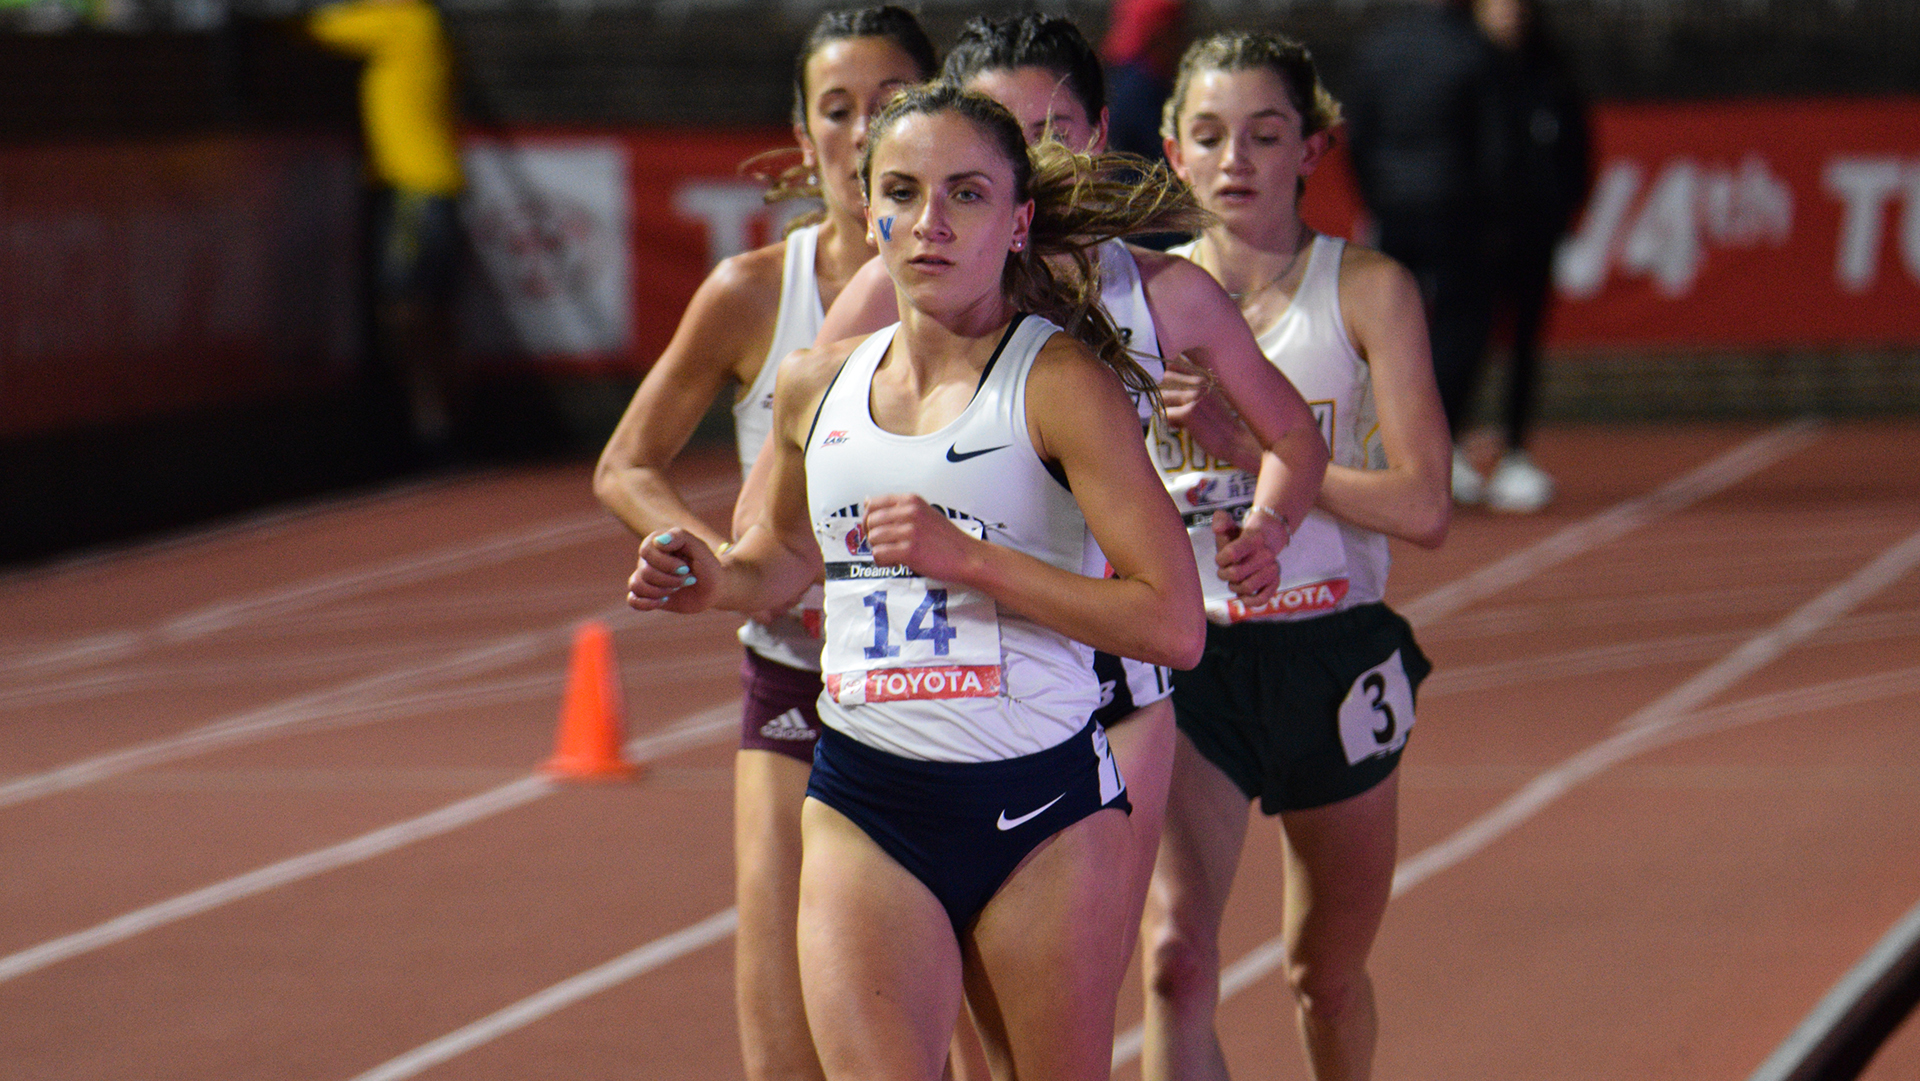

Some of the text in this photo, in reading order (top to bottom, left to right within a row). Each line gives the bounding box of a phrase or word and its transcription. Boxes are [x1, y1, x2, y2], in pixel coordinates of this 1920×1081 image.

[878, 216, 896, 242] V
[850, 564, 890, 578] Dream
[863, 588, 957, 660] 14
[873, 671, 982, 696] TOYOTA
[1363, 672, 1396, 744] 3
